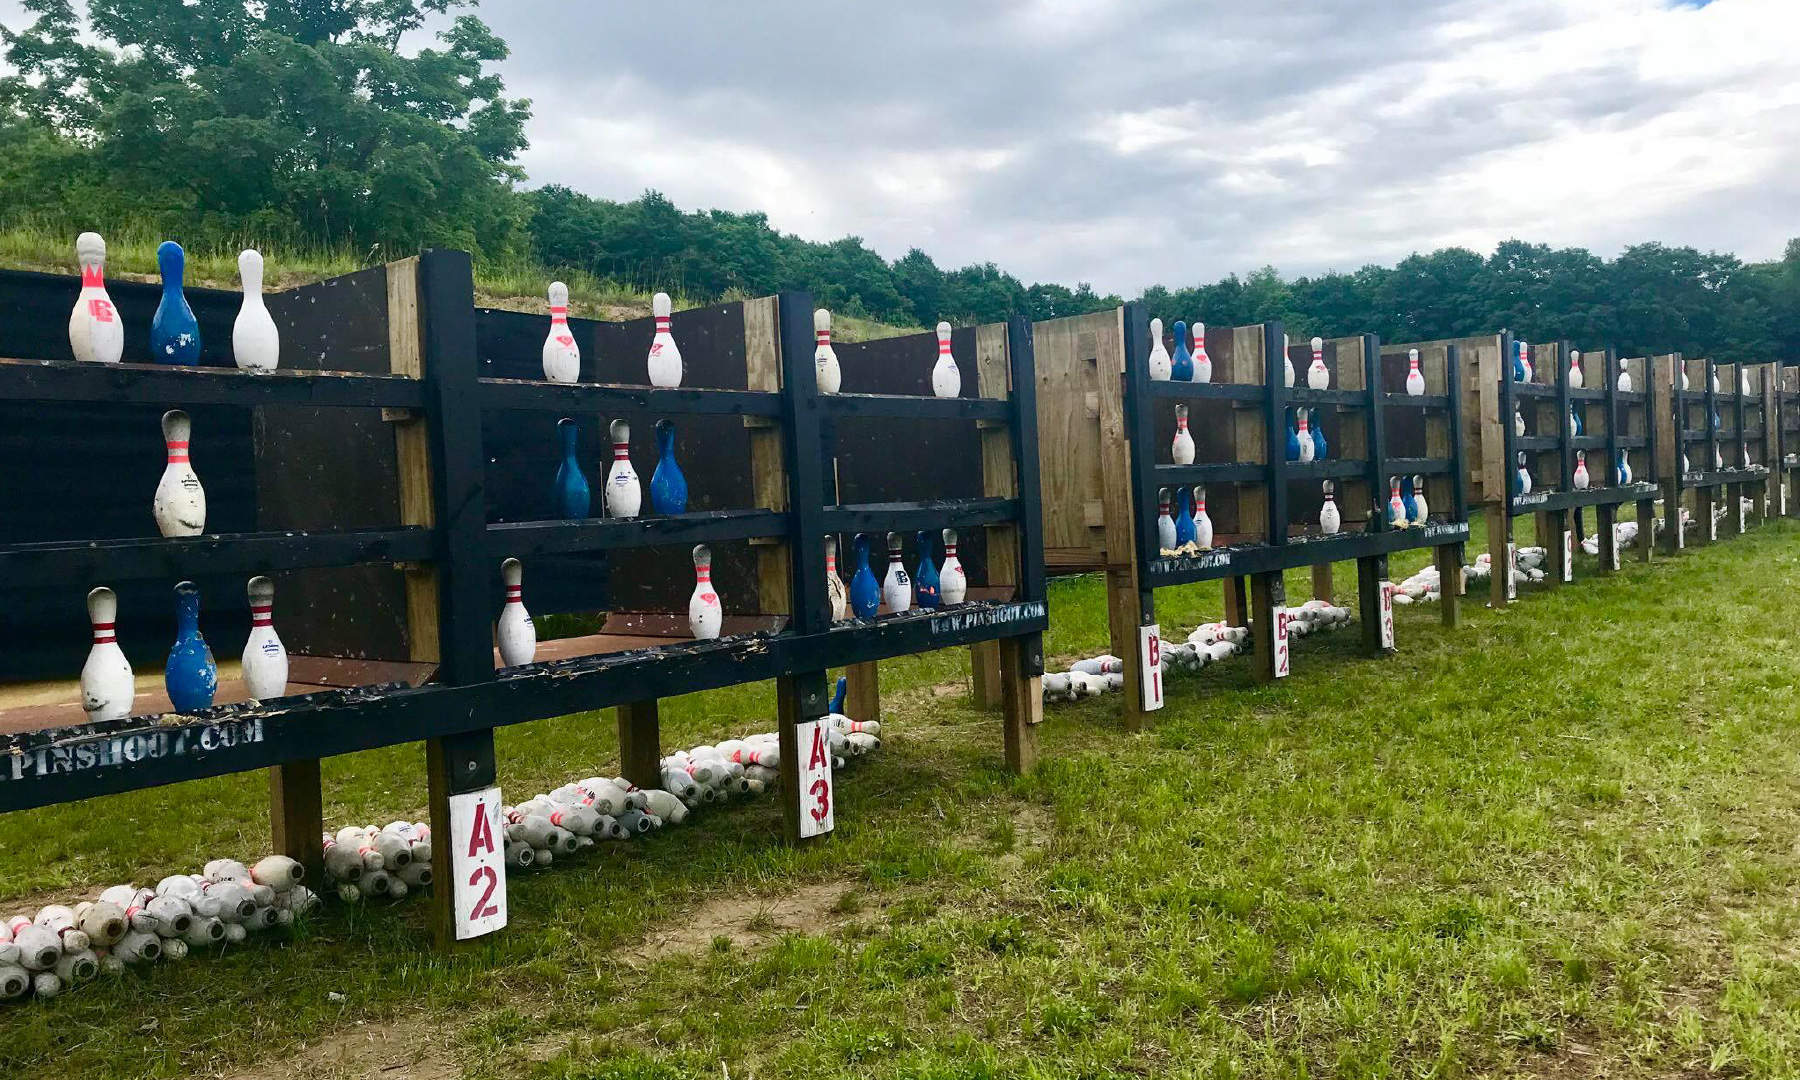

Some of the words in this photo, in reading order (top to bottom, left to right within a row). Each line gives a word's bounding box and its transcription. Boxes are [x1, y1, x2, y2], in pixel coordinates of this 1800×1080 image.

[1148, 635, 1159, 667] B
[809, 727, 827, 770] A
[810, 779, 828, 821] 3
[468, 803, 495, 857] A
[469, 866, 498, 920] 2
